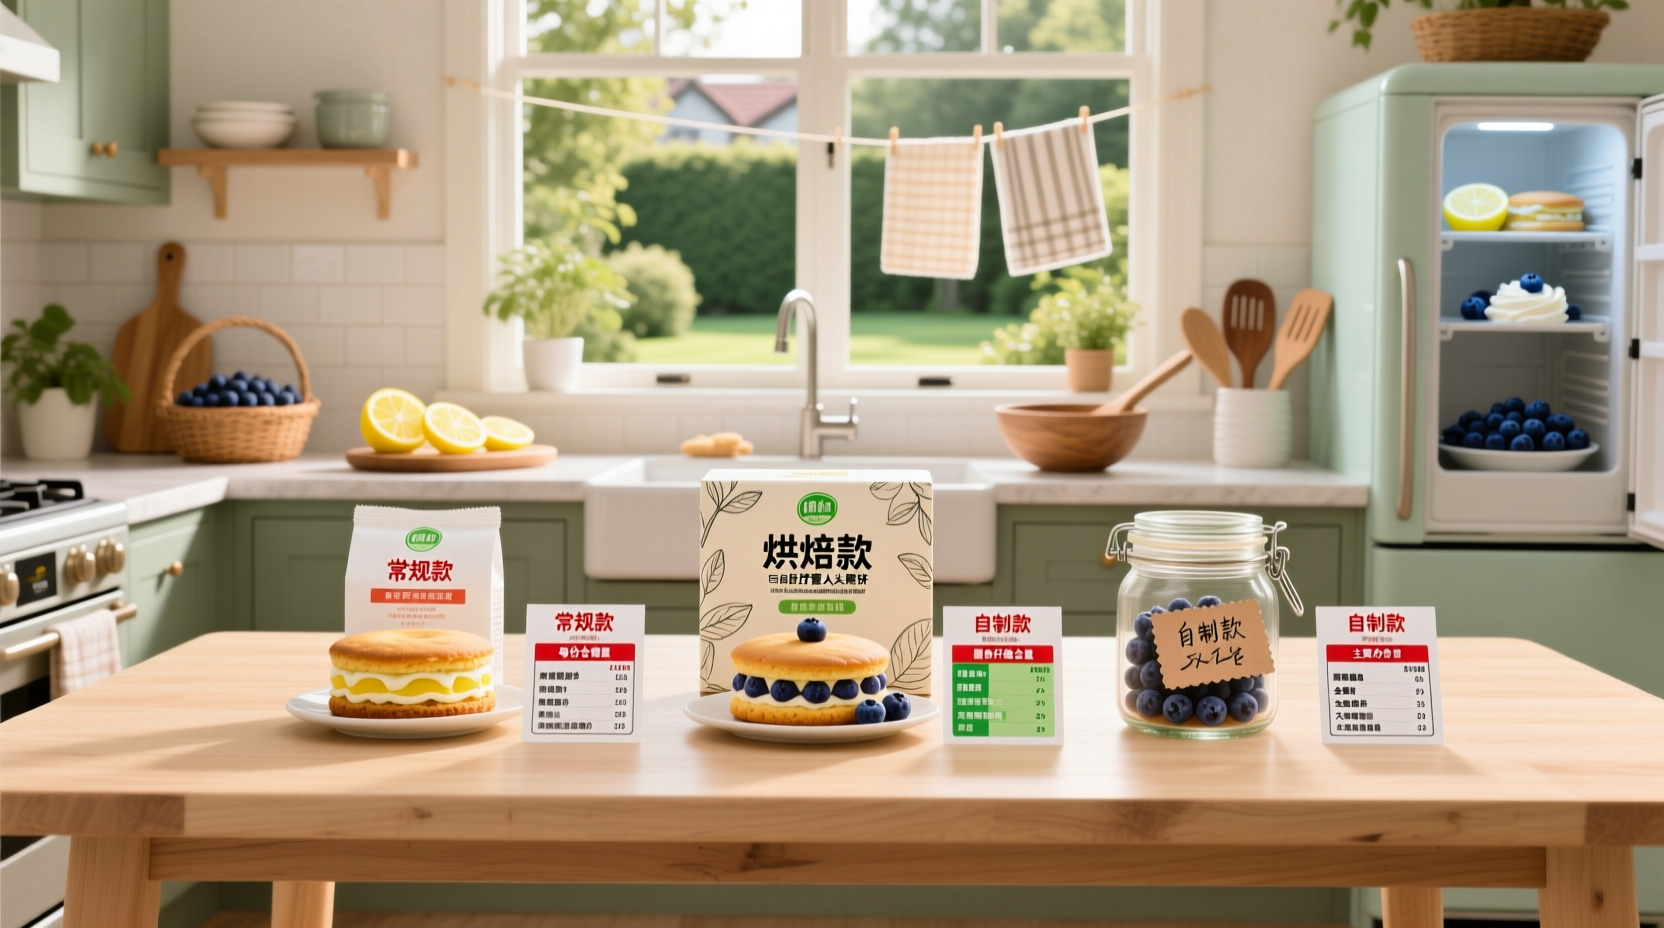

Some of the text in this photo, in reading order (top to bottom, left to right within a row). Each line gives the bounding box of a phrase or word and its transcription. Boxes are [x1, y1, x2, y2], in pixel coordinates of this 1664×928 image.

[763, 533, 872, 570] 烘焙款
[387, 558, 453, 582] 常规款
[555, 611, 614, 632] 常规款
[975, 613, 1031, 633] 自制款
[1178, 616, 1246, 648] 自制款
[1348, 612, 1405, 633] 自制款
